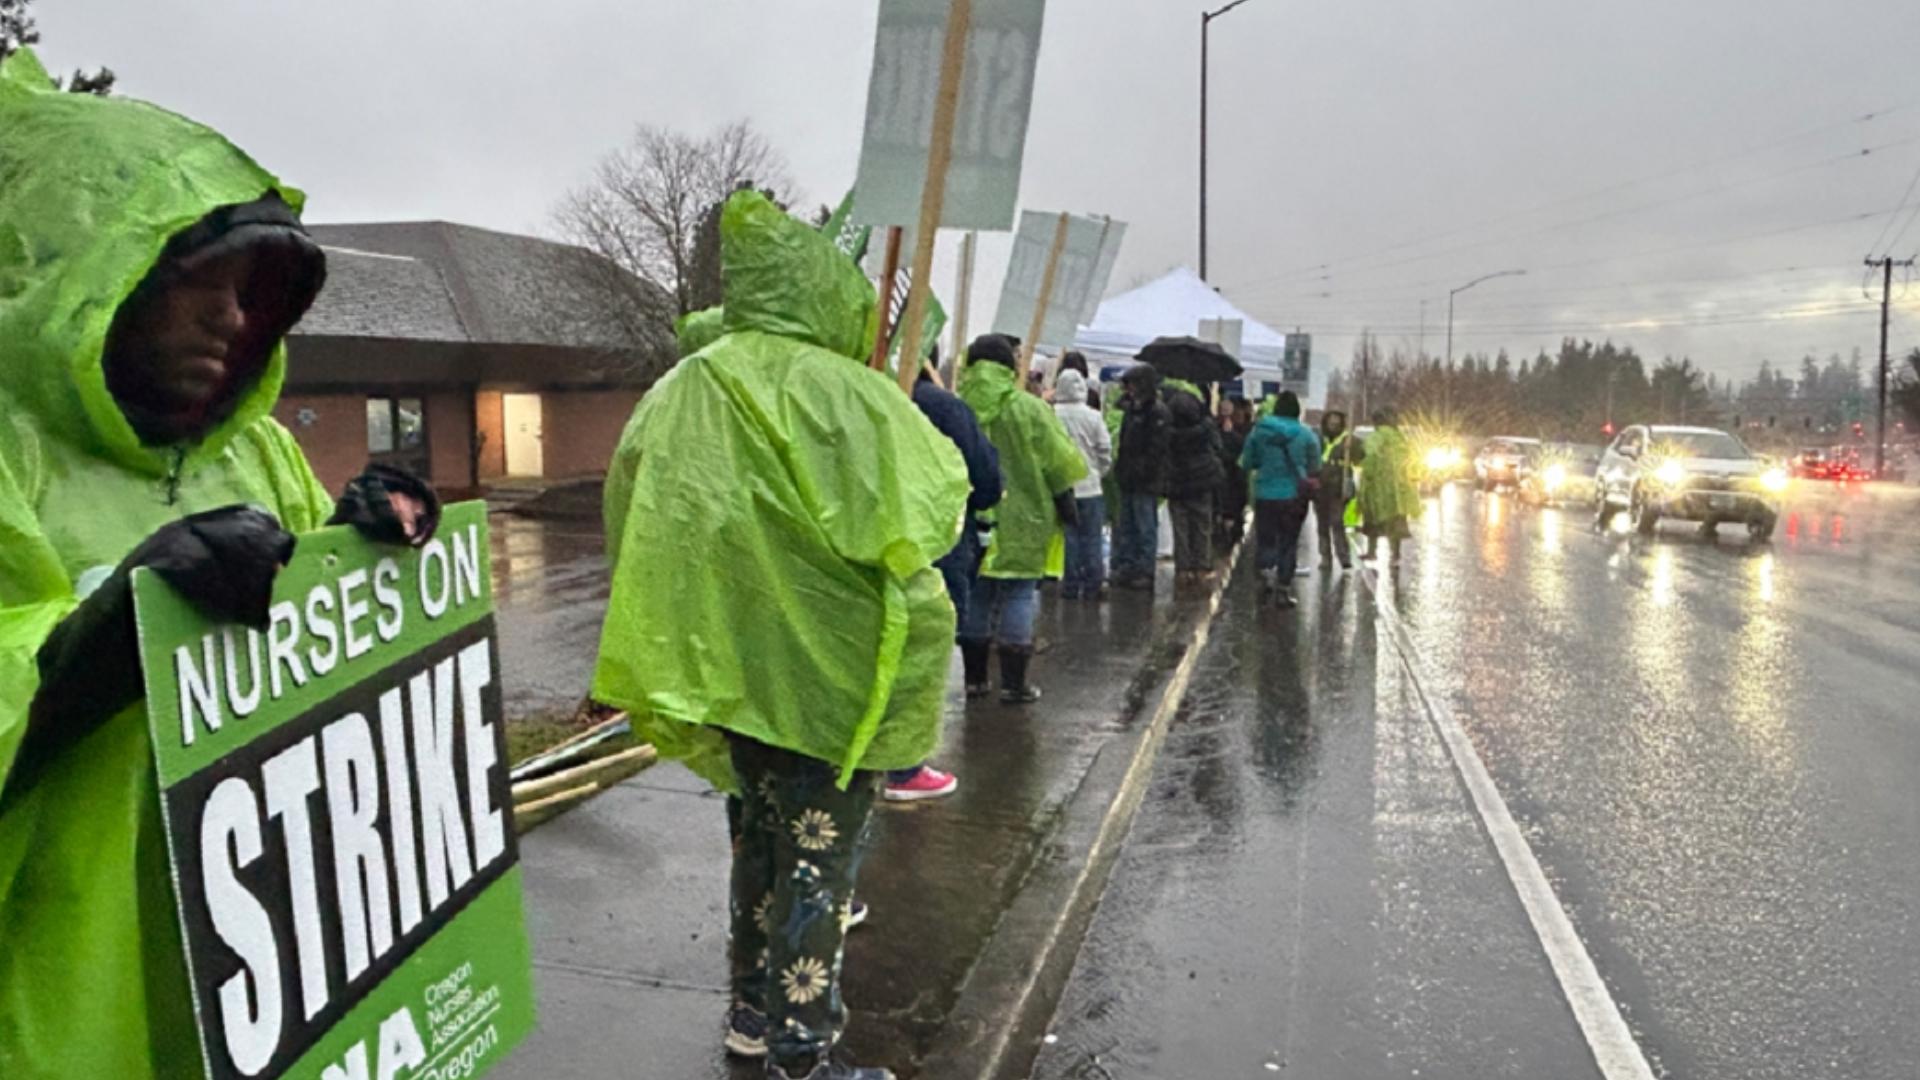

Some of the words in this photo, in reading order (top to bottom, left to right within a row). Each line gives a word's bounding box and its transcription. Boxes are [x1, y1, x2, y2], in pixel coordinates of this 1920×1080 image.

[174, 557, 404, 746] NURSES
[420, 523, 481, 619] ON
[200, 638, 505, 1076] STRIKE
[425, 961, 472, 1006] Oregon
